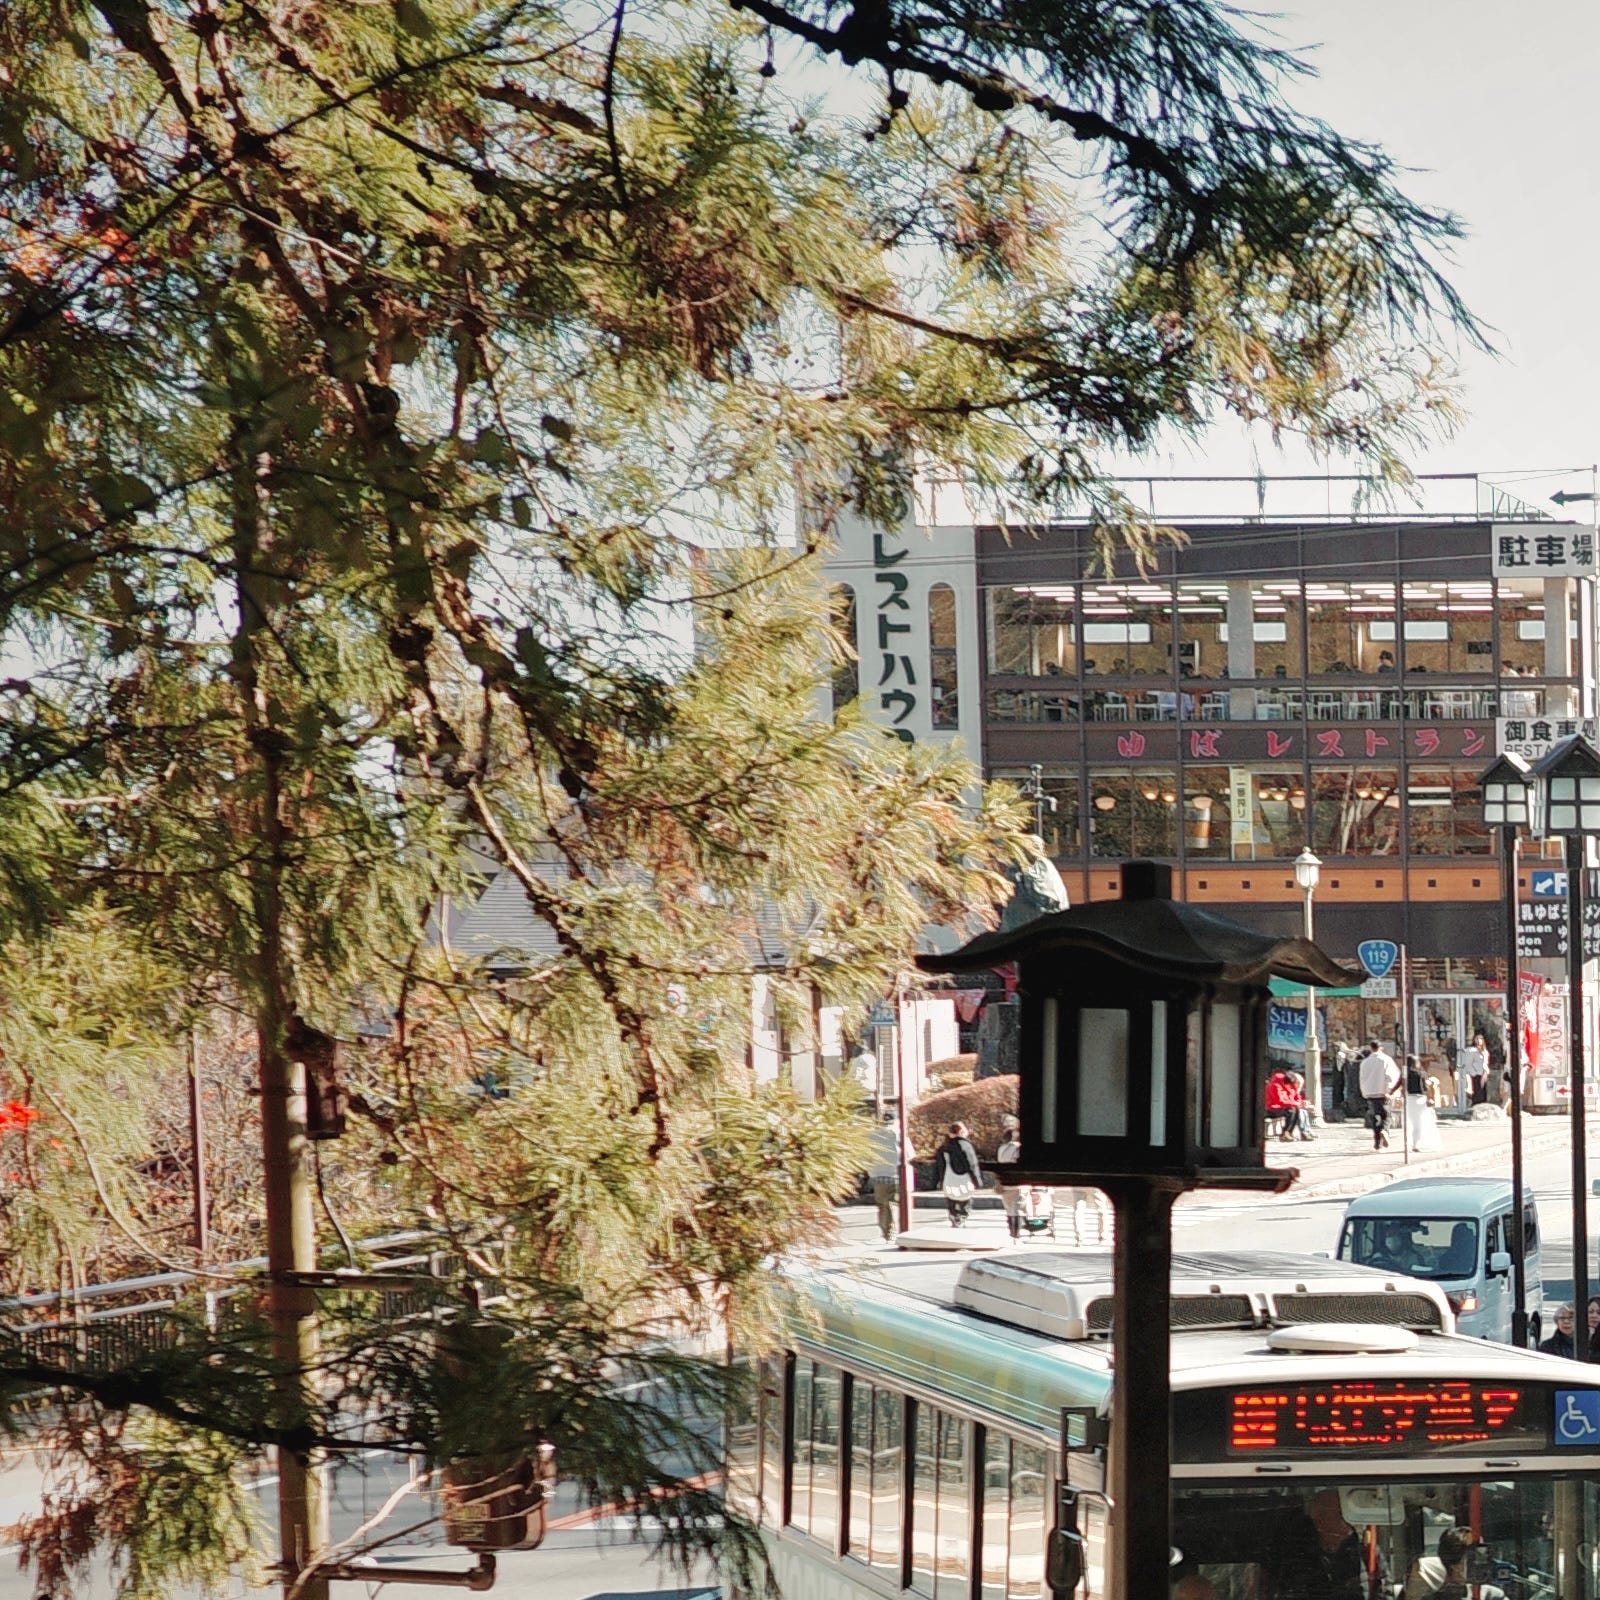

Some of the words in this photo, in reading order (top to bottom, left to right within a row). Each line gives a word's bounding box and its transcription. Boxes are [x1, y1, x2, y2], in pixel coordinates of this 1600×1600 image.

[1498, 534, 1593, 568] 駐車場
[873, 500, 916, 744] レストハウ
[1504, 719, 1597, 743] 御食事処
[1117, 729, 1486, 758] ゆばレストラン
[1368, 950, 1389, 964] 119
[1270, 1006, 1306, 1027] Silk
[1270, 1023, 1295, 1039] Ice
